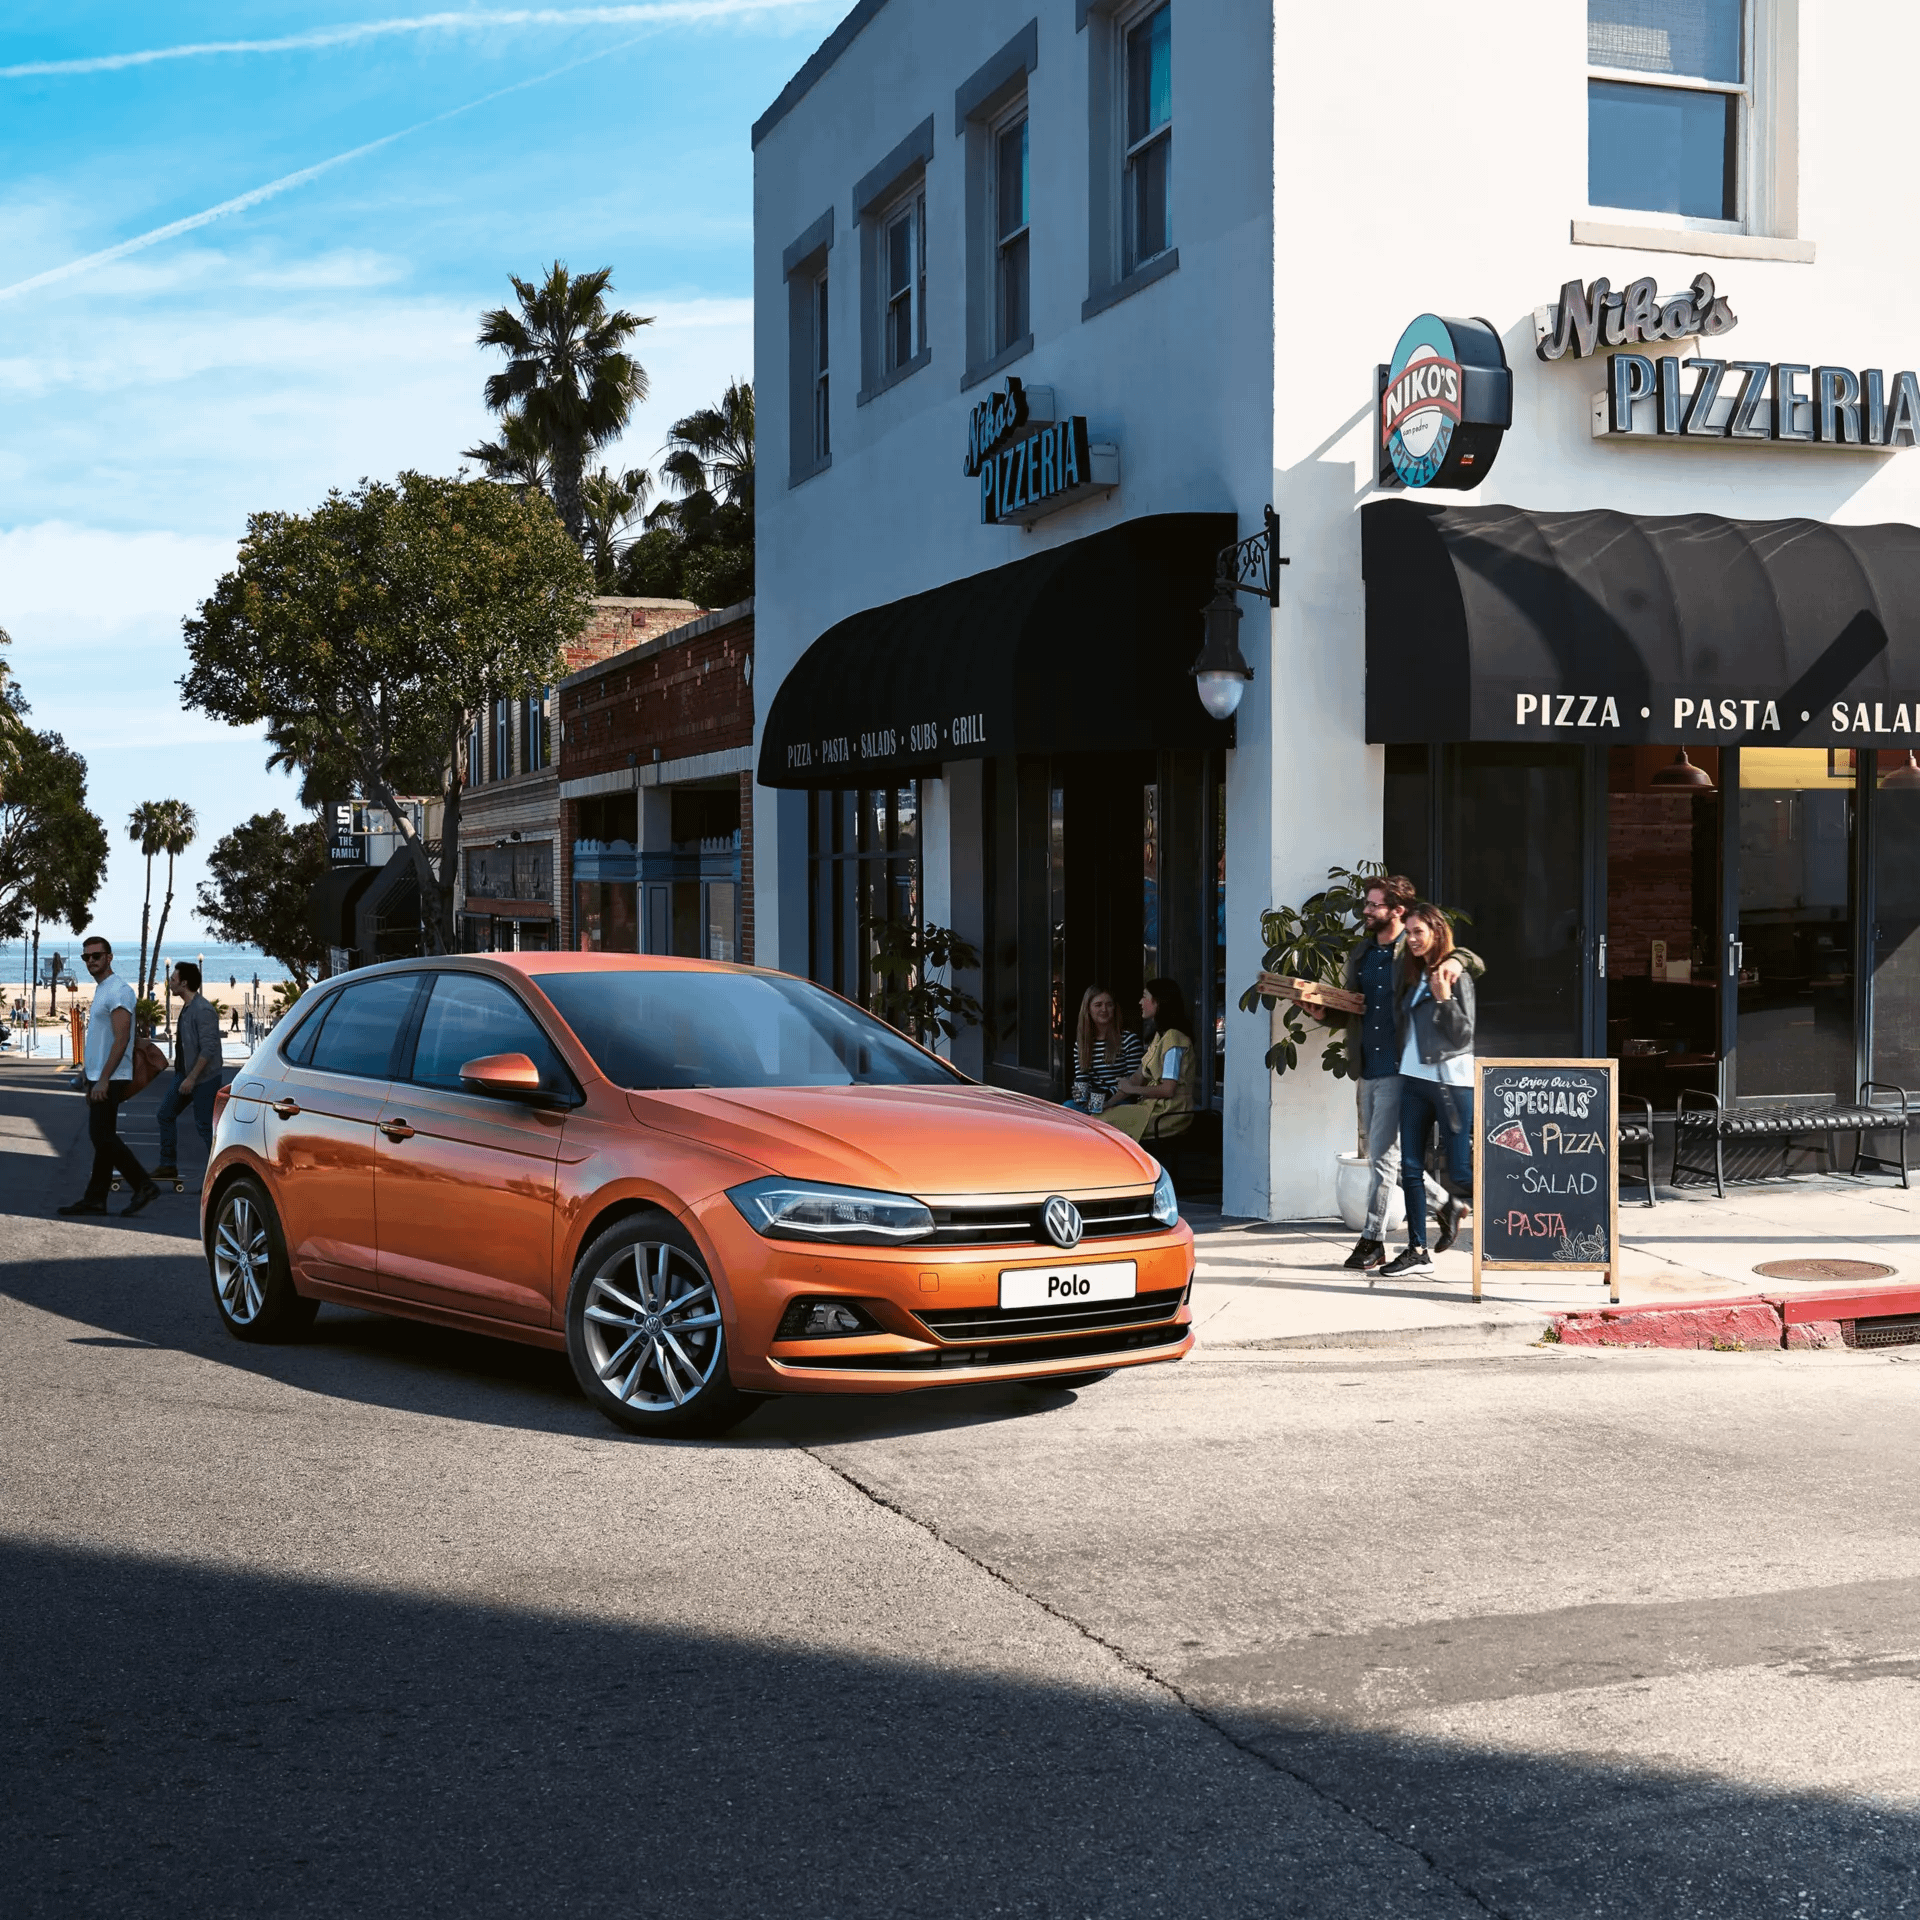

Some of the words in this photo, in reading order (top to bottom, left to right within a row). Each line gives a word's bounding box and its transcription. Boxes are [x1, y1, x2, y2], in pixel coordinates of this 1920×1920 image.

[1536, 272, 1738, 362] Niko's
[1386, 364, 1458, 429] NIKO'S
[1607, 354, 1920, 447] PIZZERIA
[963, 376, 1021, 477] Niko's
[1402, 428, 1411, 437] san
[1412, 417, 1429, 436] pedro
[981, 416, 1083, 524] PIZZERIA
[1392, 426, 1452, 485] PIZZERIA
[1516, 693, 1620, 728] PIZZA
[1674, 697, 1781, 731] PASTA
[787, 743, 812, 768] PIZZA
[822, 737, 850, 763] PASTA
[861, 728, 896, 758] SALADS
[910, 722, 938, 751] SUBS
[952, 713, 986, 746] GRILL
[331, 847, 360, 859] FAMILY
[338, 836, 353, 847] THE
[1519, 1077, 1550, 1089] Enjoy
[1551, 1077, 1572, 1089] Our
[1503, 1091, 1590, 1119] SPECIALS
[1508, 1210, 1567, 1238] PASTA
[1048, 1274, 1091, 1298] Polo
